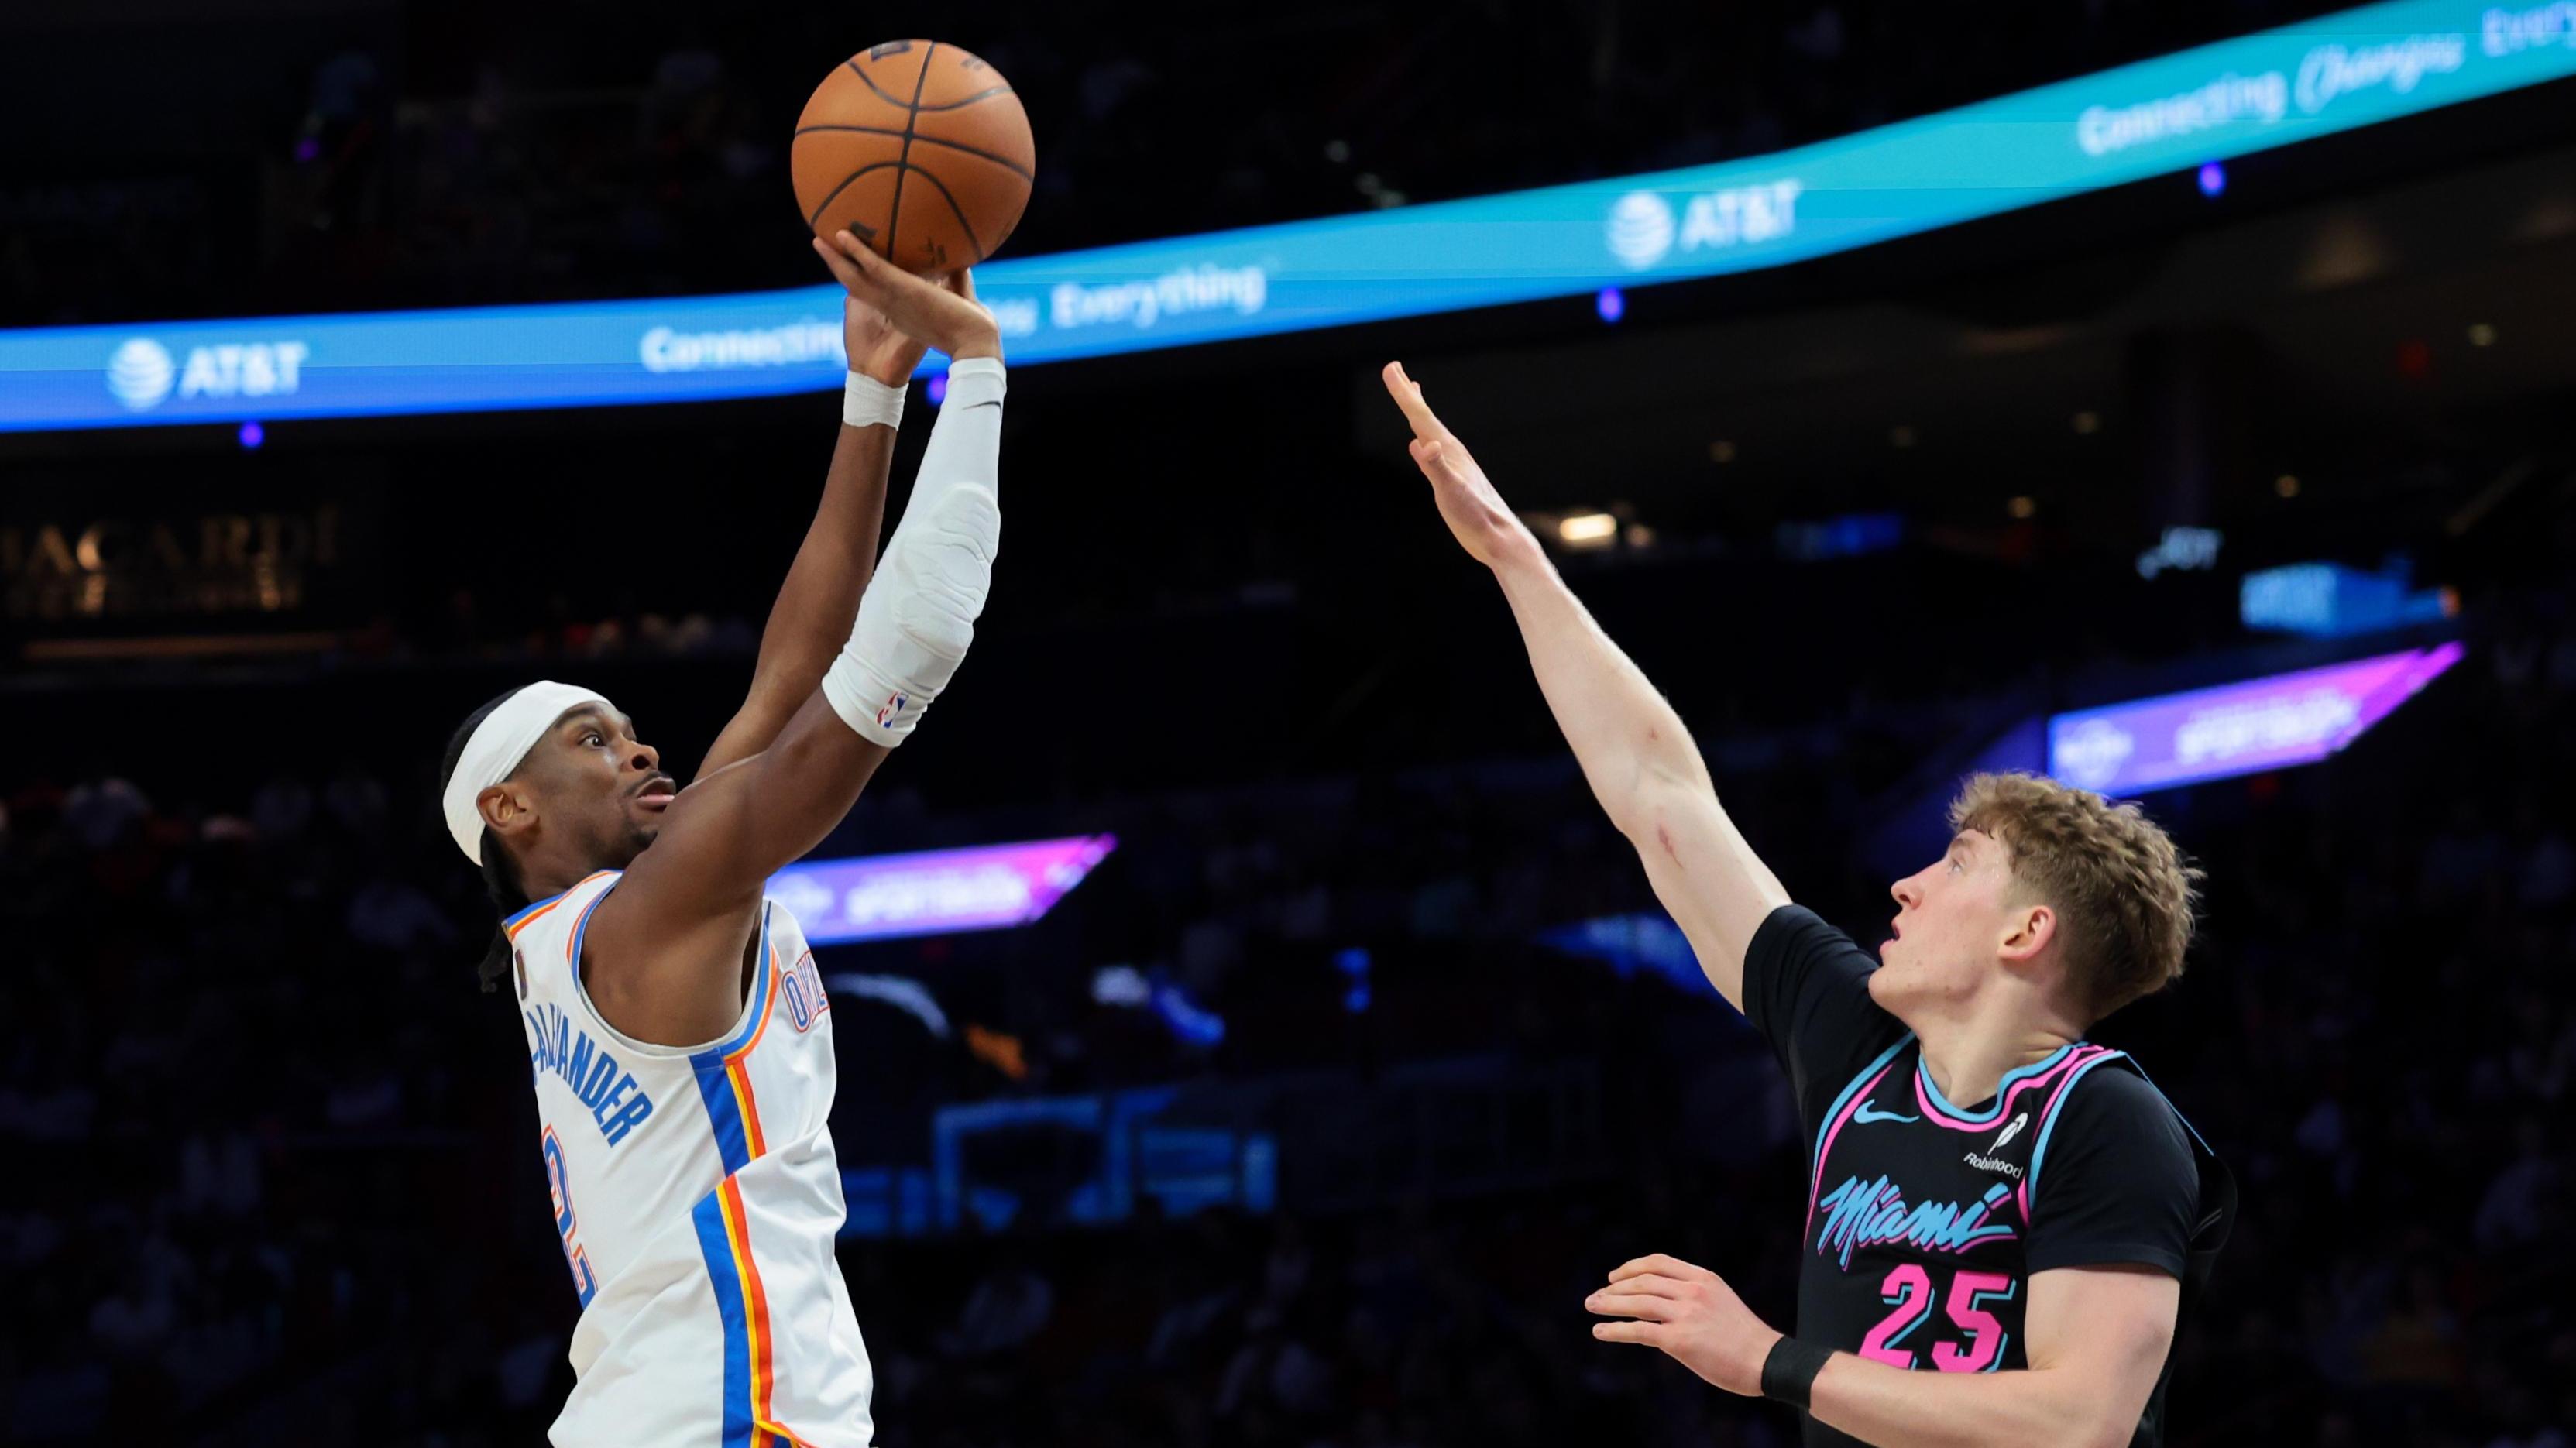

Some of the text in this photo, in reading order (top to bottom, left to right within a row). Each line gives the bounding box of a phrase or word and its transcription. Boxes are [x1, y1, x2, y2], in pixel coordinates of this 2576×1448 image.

[2078, 71, 2289, 155] Connecting
[1679, 179, 1803, 252] AT&T
[1050, 263, 1266, 329] Everything
[178, 341, 308, 399] AT&T
[1963, 1151, 2024, 1179] Robinhood
[1817, 1174, 2018, 1271] Miami
[1858, 1263, 2017, 1374] 25
